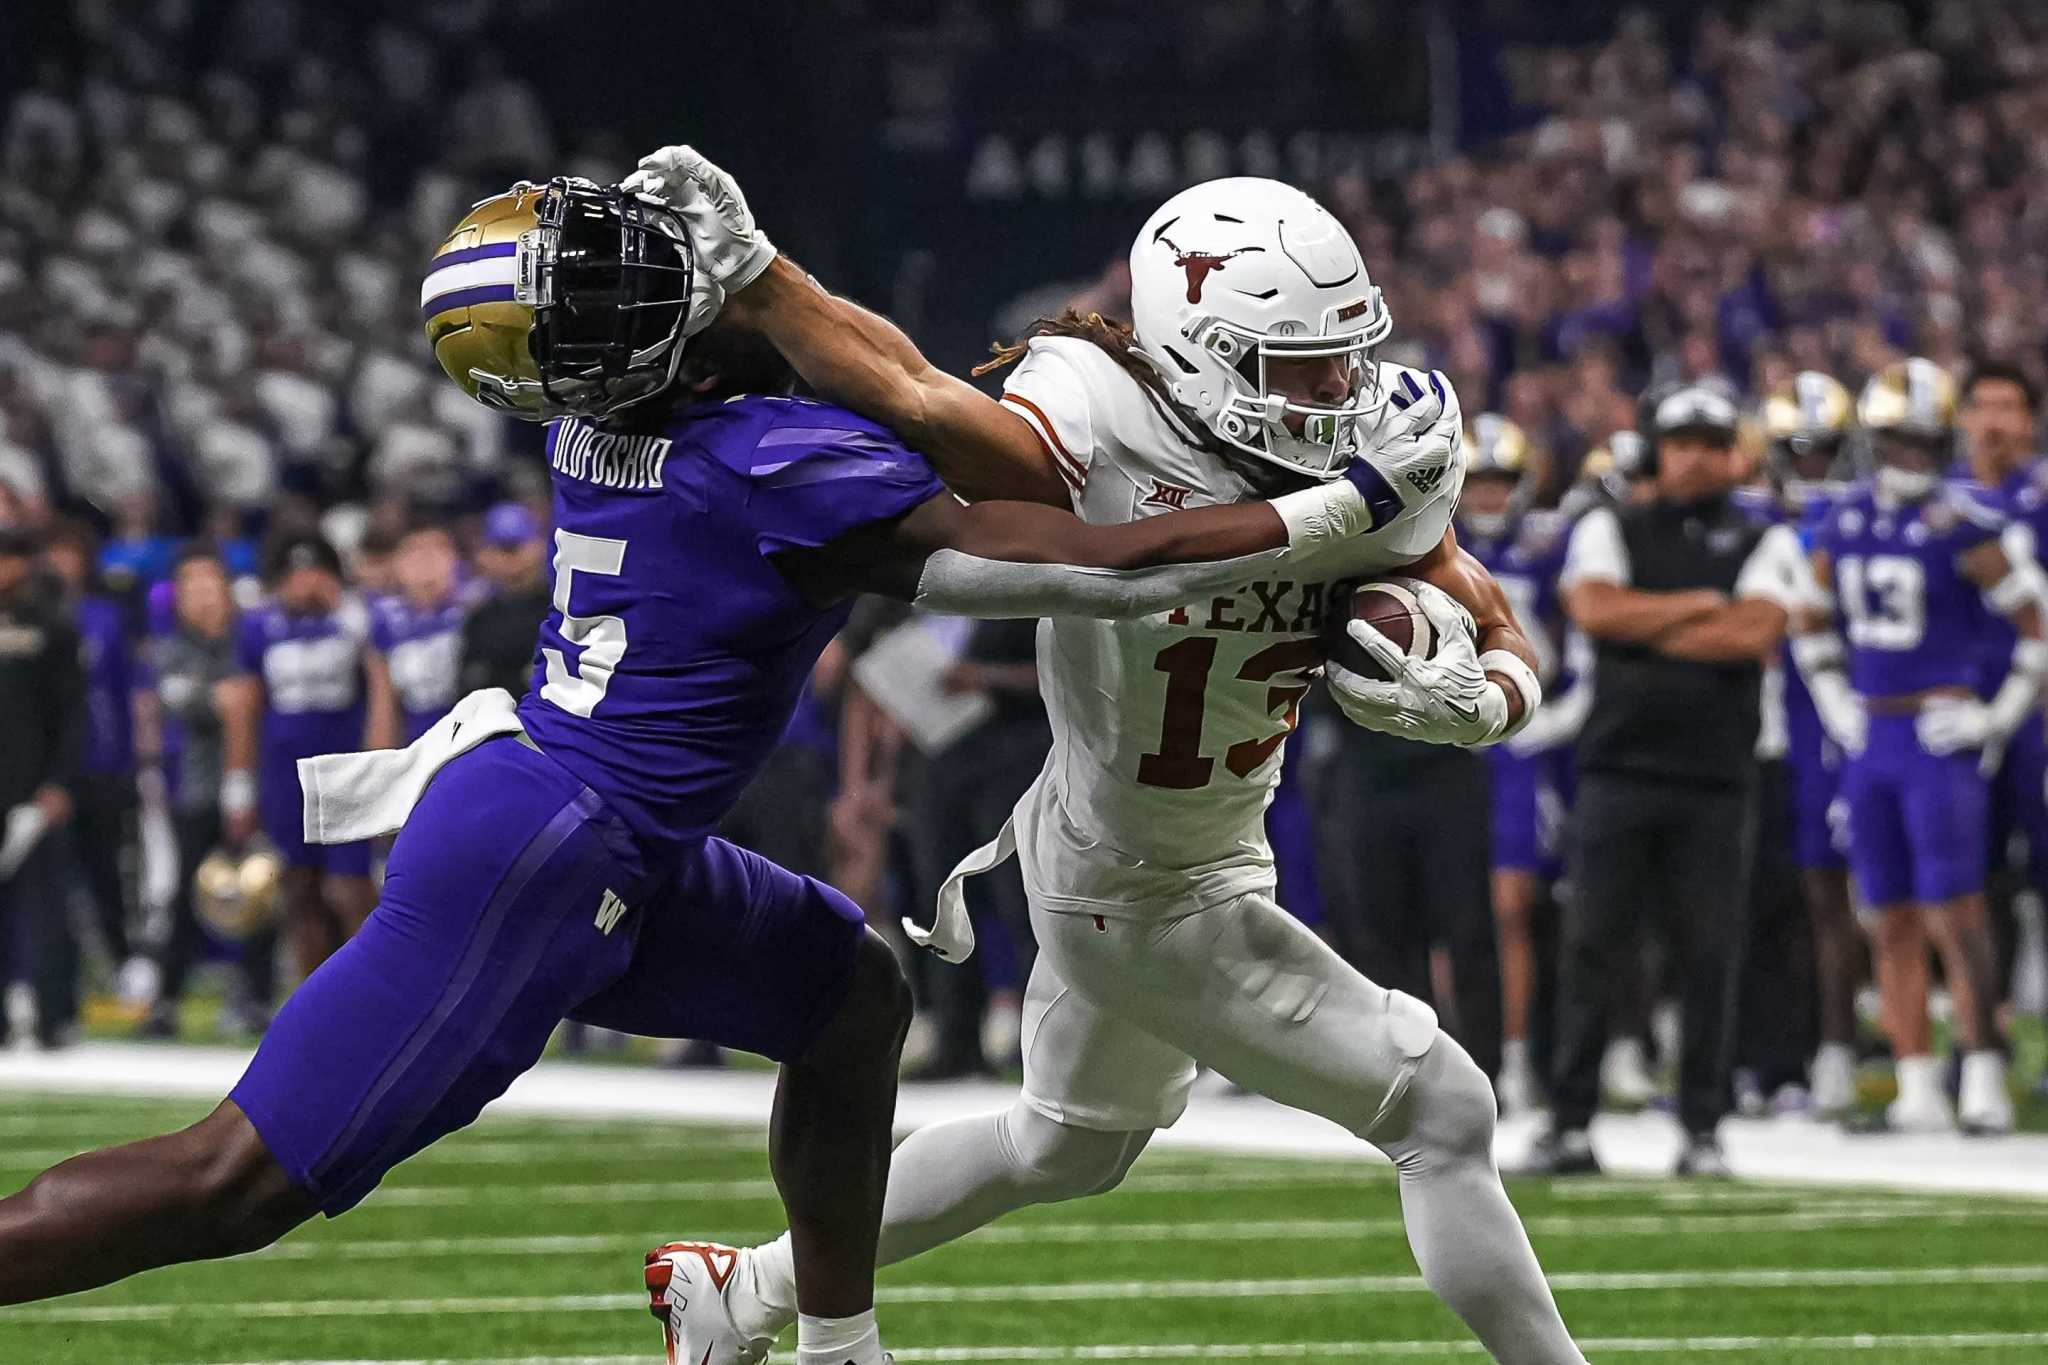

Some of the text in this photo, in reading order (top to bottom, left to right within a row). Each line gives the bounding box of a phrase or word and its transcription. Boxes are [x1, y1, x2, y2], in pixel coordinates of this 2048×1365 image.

[540, 527, 628, 719] 5
[1837, 554, 1926, 651] 13
[1136, 636, 1322, 790] 13
[594, 888, 627, 936] W
